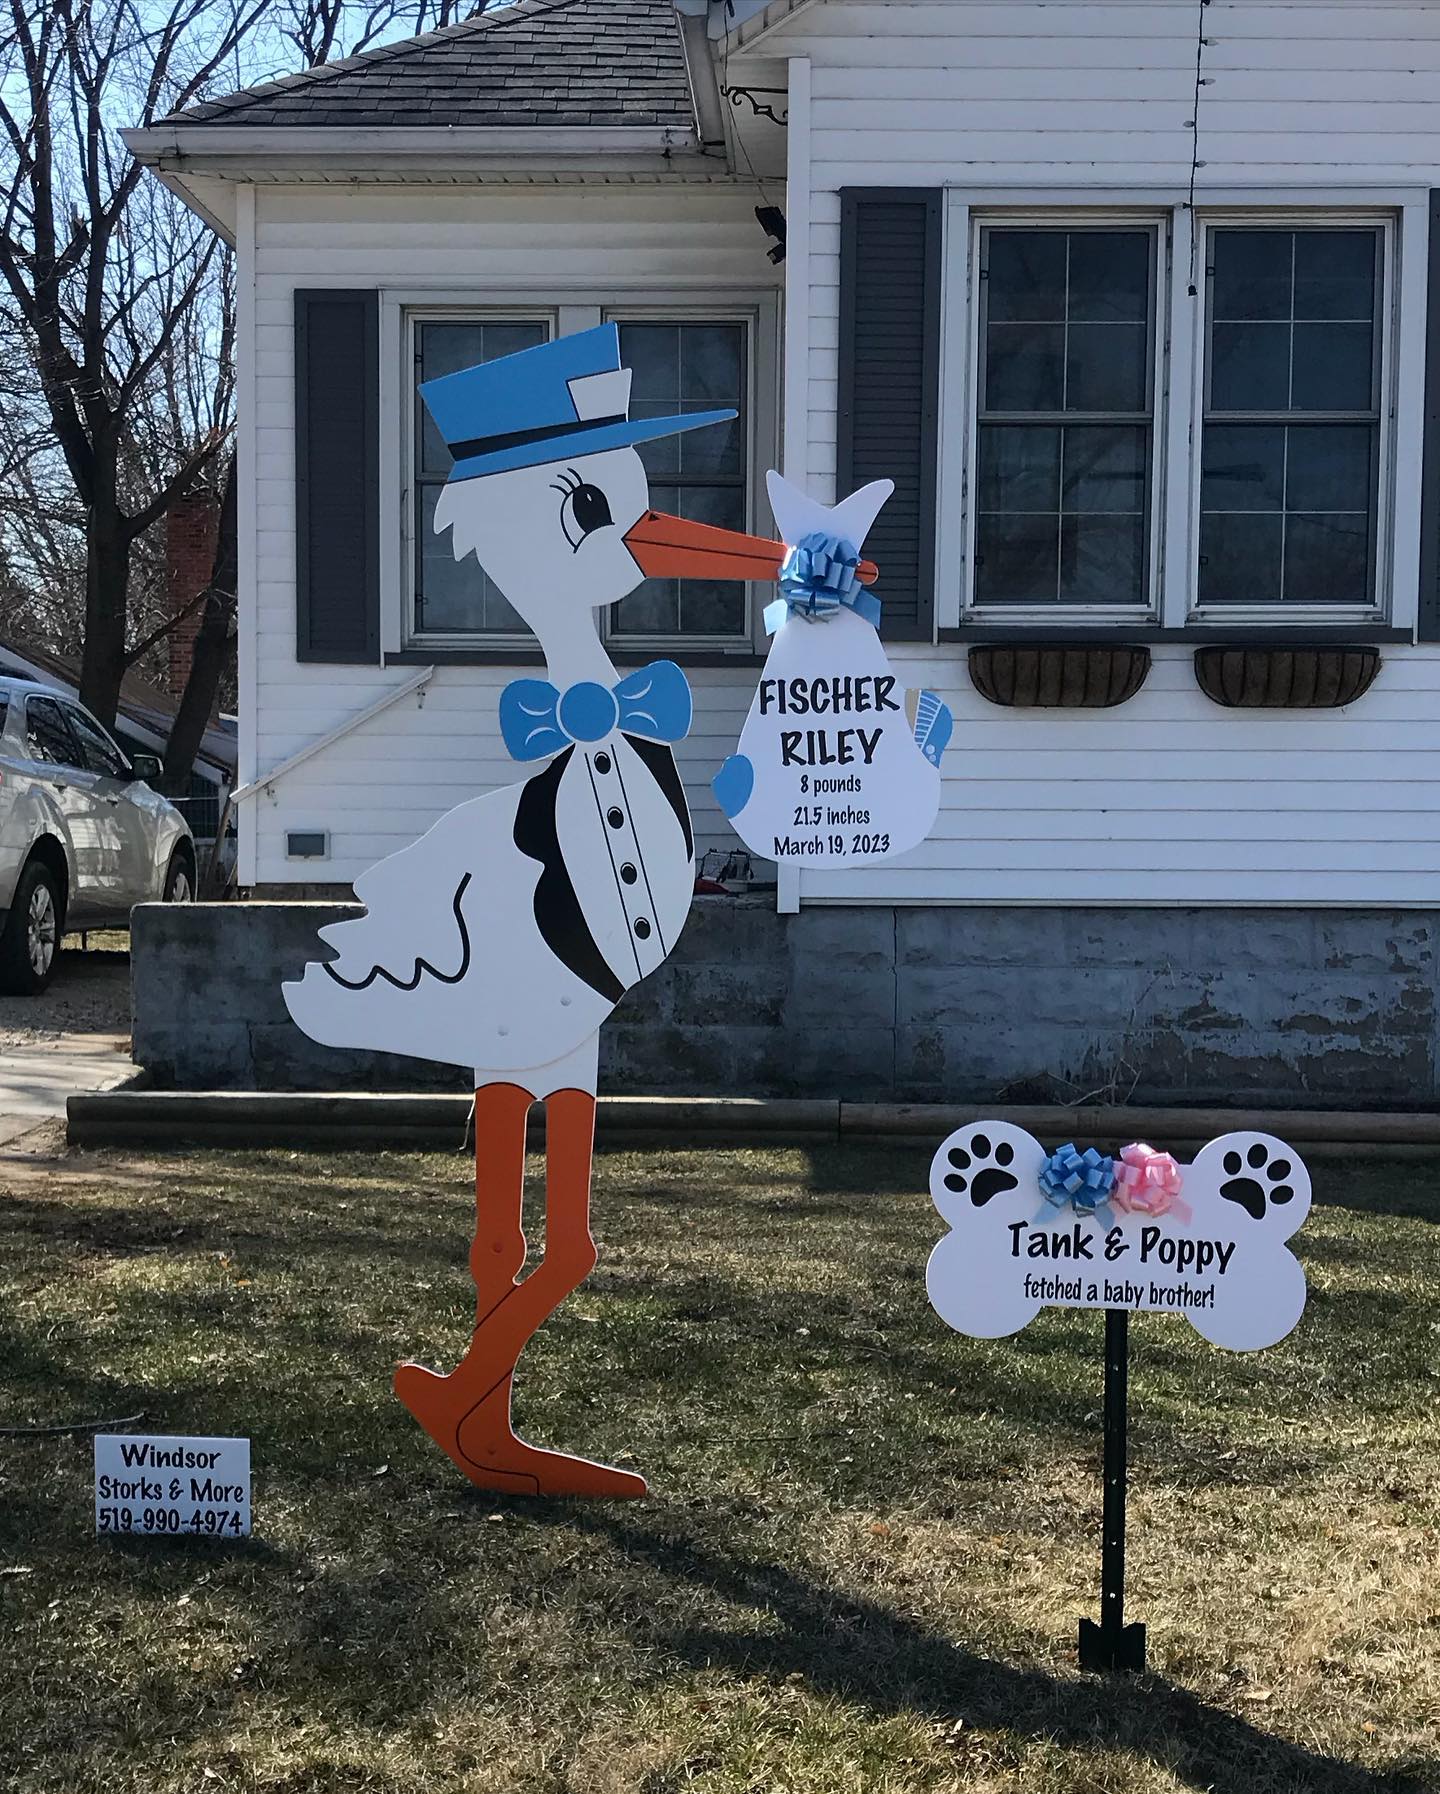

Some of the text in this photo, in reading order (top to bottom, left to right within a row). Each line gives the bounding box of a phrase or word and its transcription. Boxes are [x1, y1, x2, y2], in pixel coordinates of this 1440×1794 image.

[759, 675, 901, 715] FISCHER
[780, 728, 884, 766] RILEY
[800, 774, 862, 797] 8 pounds
[793, 805, 870, 826] 21.5 inches
[773, 833, 890, 856] March 19, 2023
[1007, 1220, 1236, 1275] Tank & Poppy
[1024, 1273, 1215, 1308] fetched a baby brother!
[120, 1443, 222, 1469] Windsor
[99, 1475, 244, 1503] Storks & More
[98, 1507, 243, 1534] 519-990-4974
